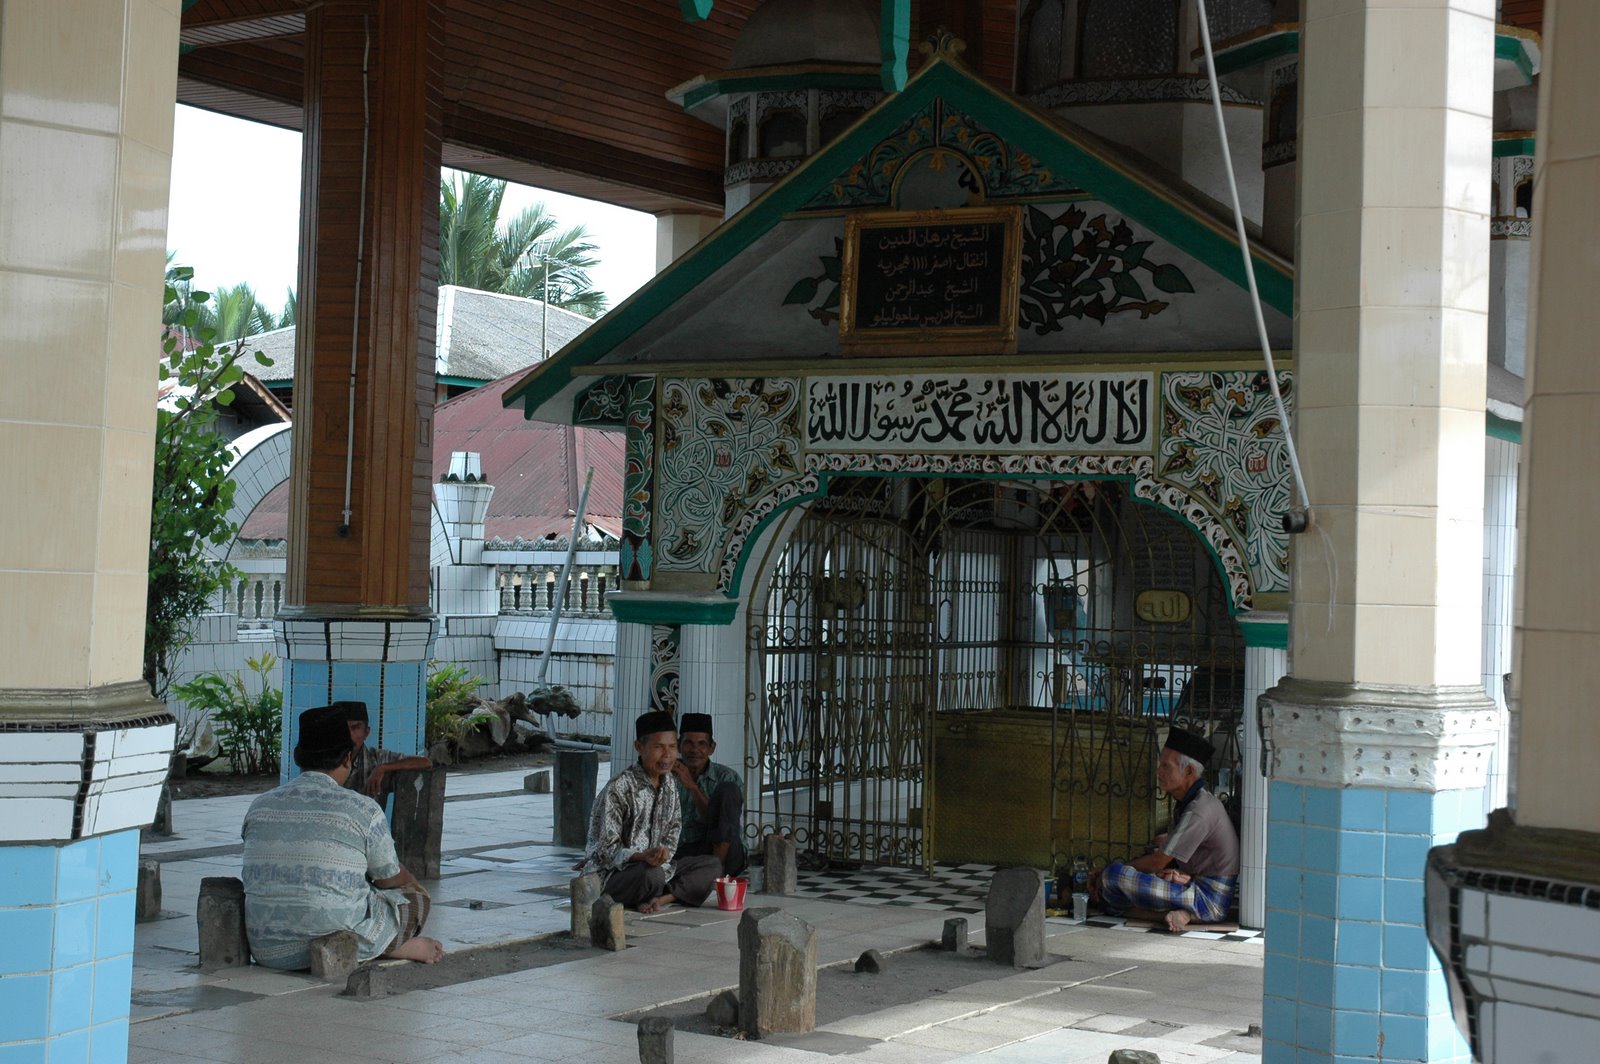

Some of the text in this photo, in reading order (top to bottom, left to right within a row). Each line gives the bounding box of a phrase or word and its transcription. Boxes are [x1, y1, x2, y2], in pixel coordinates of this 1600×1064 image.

[879, 224, 990, 251] الشيخ برهان الدين
[944, 276, 979, 302] الشيخ
[955, 304, 984, 326] الشيخ
